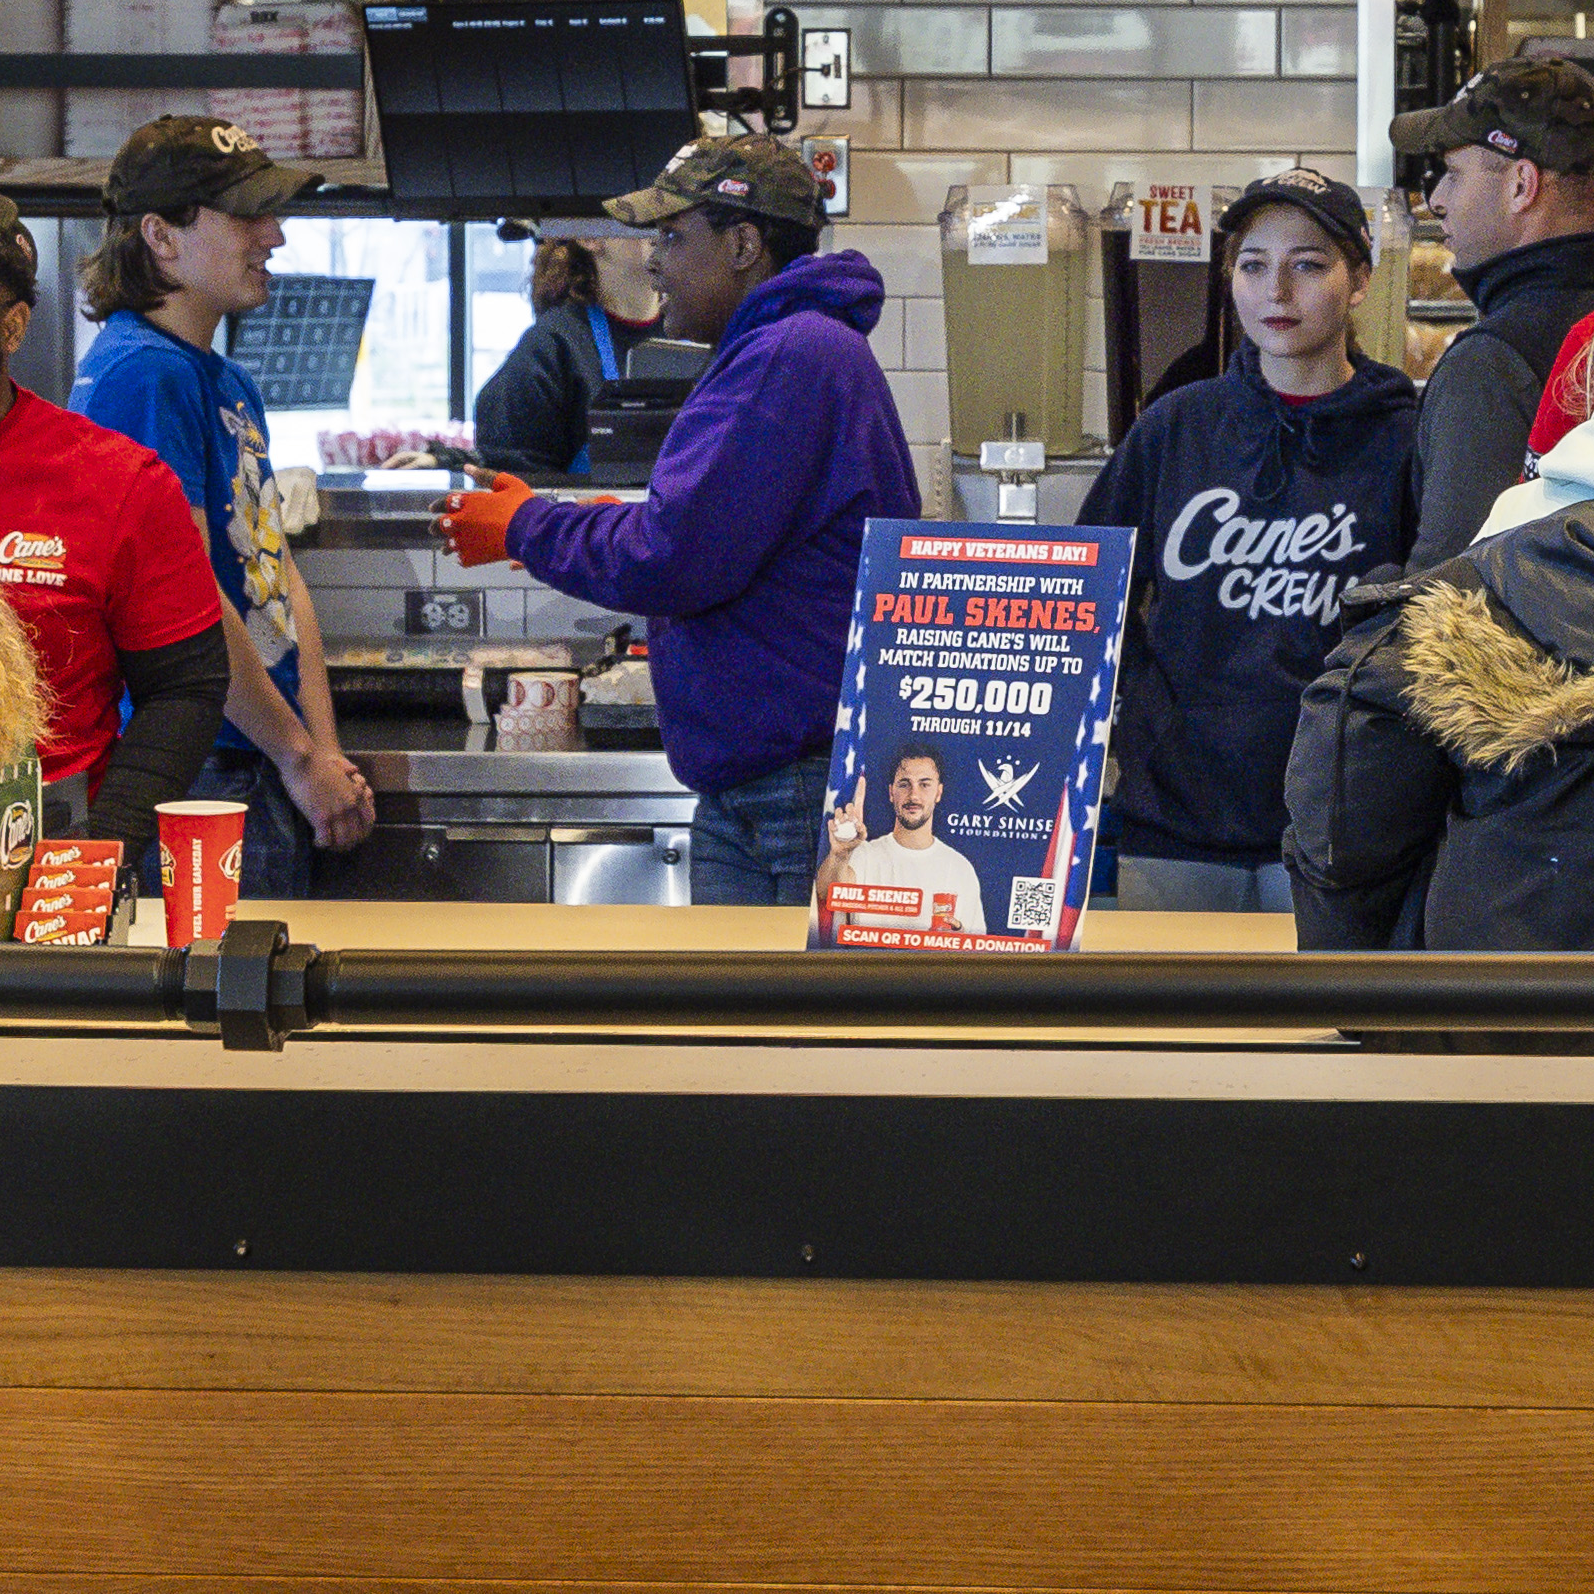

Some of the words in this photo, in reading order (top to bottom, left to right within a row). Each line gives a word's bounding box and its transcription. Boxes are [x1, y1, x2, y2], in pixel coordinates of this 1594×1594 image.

[1149, 185, 1195, 200] SWEET
[1137, 199, 1202, 235] TEA
[1163, 487, 1367, 580] Cane's
[911, 540, 960, 557] HAPPY
[965, 543, 1049, 560] VETERANS
[1051, 546, 1087, 562] DAY!
[26, 569, 68, 587] LOVE
[900, 572, 917, 589] IN
[922, 573, 1035, 594] PARTNERSHIP
[1040, 577, 1084, 595] WITH
[1218, 566, 1359, 627] CREW
[873, 593, 953, 625] PAUL
[964, 598, 1100, 633] SKENES,
[896, 628, 962, 648] RAISING
[966, 631, 1024, 650] CANE'S
[1029, 634, 1070, 652] WILL
[879, 649, 934, 667] MATCH
[938, 651, 1030, 672] DONATIONS
[1034, 655, 1058, 673] UP
[1062, 657, 1083, 674] TO
[899, 675, 1052, 715] $250,000
[911, 716, 981, 735] THROUGH
[985, 719, 1031, 738] 11/14
[947, 813, 992, 829] GARY
[999, 816, 1054, 832] SINISE
[959, 828, 1038, 840] FOUNDATION
[41, 845, 82, 865] Cane's
[192, 837, 203, 884] GAMEDAY
[35, 869, 77, 889] Cane's
[31, 893, 74, 913] Cane's
[192, 885, 203, 912] YOUR
[832, 886, 865, 901] PAUL
[868, 889, 919, 904] SKENES
[24, 914, 67, 944] Cane's
[192, 913, 203, 939] FUEL
[843, 930, 879, 943] SCAN
[881, 933, 900, 945] QR
[903, 934, 921, 946] TO
[924, 935, 961, 950] MAKE
[963, 937, 973, 950] A
[975, 938, 1046, 953] DONATION
